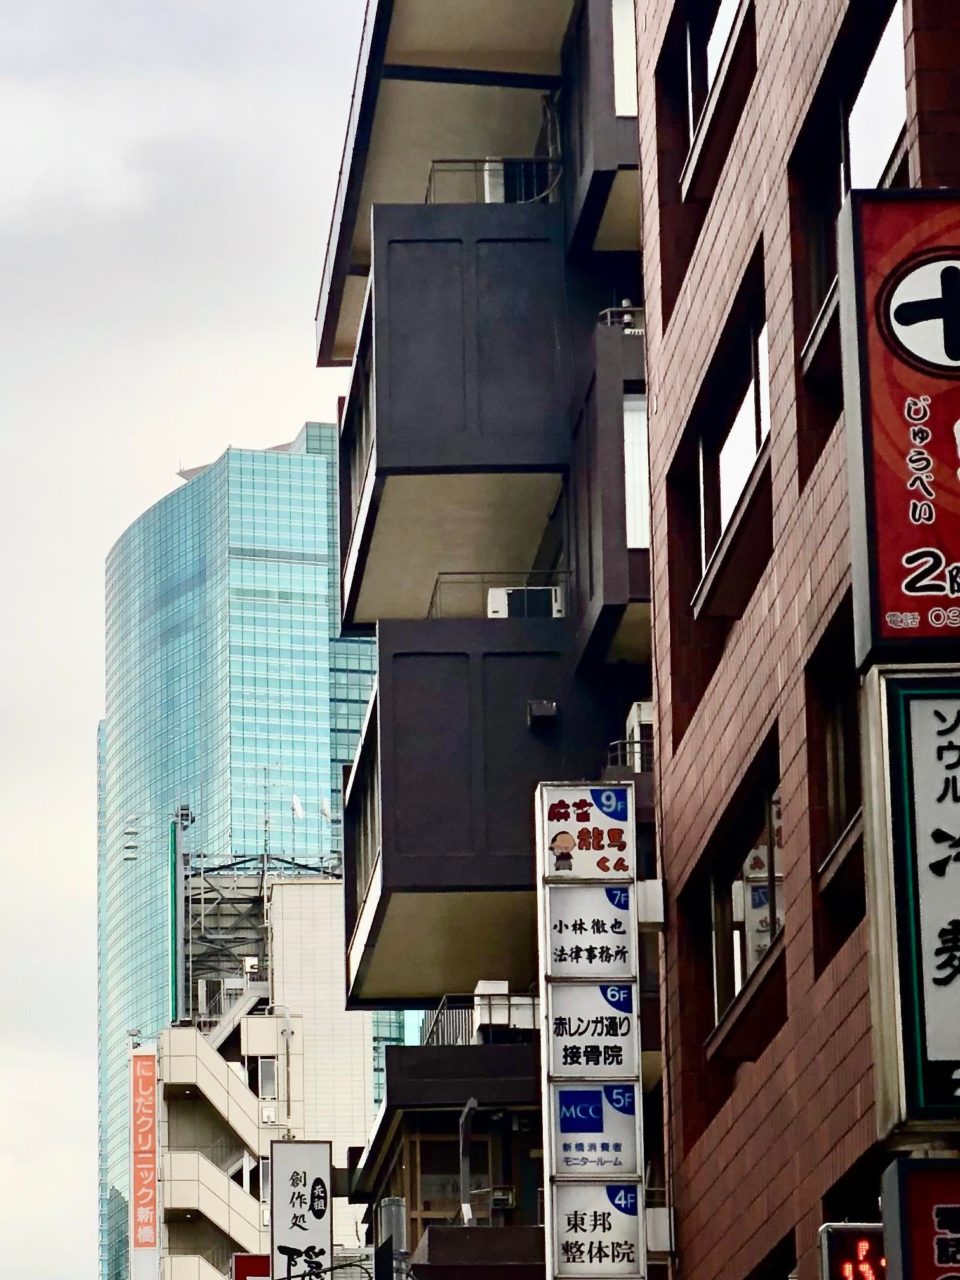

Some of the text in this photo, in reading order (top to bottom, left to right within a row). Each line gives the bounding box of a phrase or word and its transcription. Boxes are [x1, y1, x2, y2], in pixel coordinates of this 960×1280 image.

[601, 790, 625, 813] 9F
[596, 856, 629, 872] くん
[612, 890, 628, 905] 7F
[552, 918, 627, 935] 小林徹也
[553, 947, 628, 965] 法律事務所
[606, 986, 628, 1001] 6F
[553, 1016, 630, 1038] 赤レンガ通り
[562, 1045, 623, 1066] 接骨院
[612, 1089, 632, 1108] 5F
[560, 1104, 601, 1119] MCC
[135, 1060, 155, 1244] にしだクリニック新橋
[562, 1142, 622, 1152] 新橋消費者
[563, 1156, 623, 1166] モニタールーム
[289, 1170, 309, 1231] 創作処
[614, 1190, 635, 1208] 4F
[564, 1210, 612, 1233] 東邦
[561, 1240, 635, 1264] 整体院
